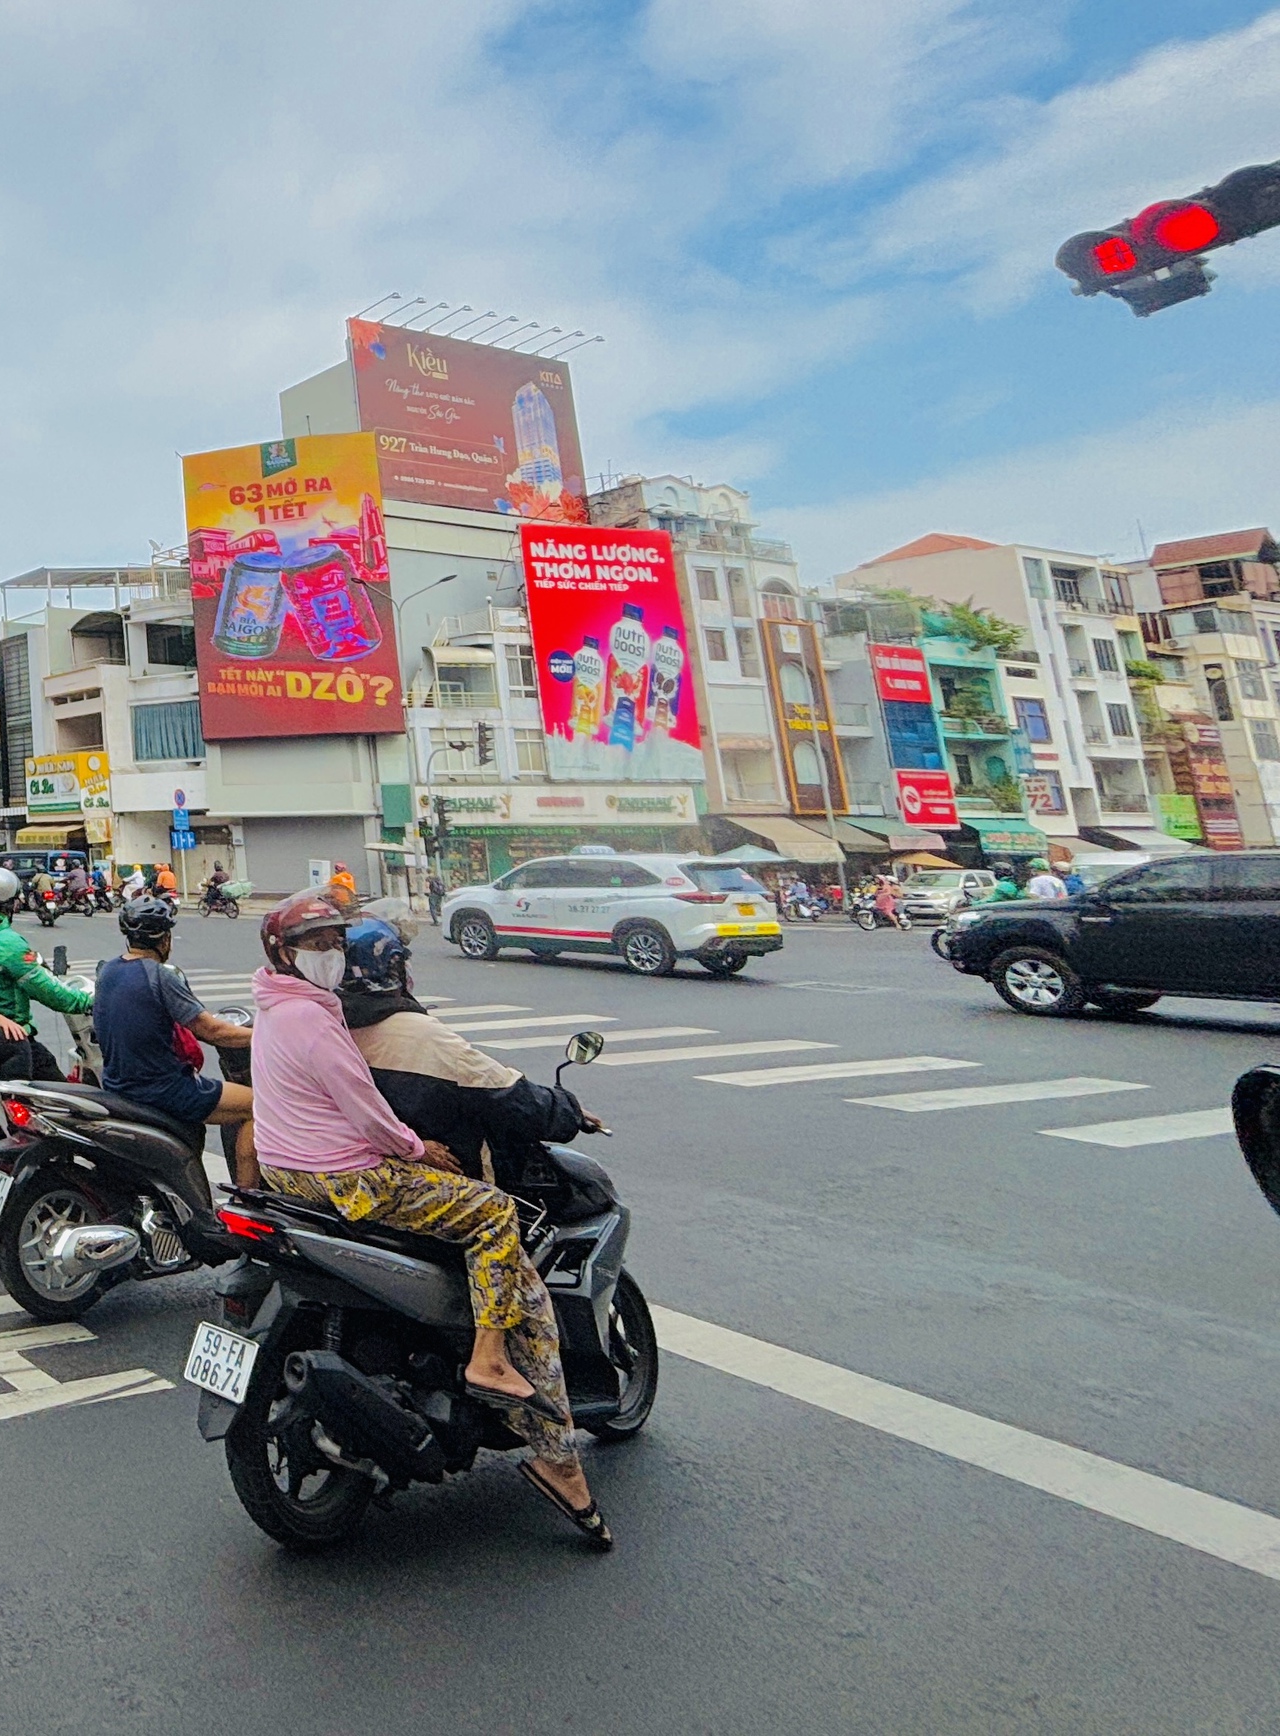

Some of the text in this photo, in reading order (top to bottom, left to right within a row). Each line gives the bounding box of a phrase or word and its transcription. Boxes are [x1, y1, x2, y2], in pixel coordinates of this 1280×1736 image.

[406, 343, 448, 377] Kiều
[380, 435, 407, 453] 927
[429, 445, 453, 459] Hưng
[471, 452, 493, 464] Quận
[493, 456, 499, 464] 5
[229, 477, 333, 506] 63 MỞ RA
[254, 497, 308, 525] 1 TẾT
[530, 539, 666, 566] NĂNG LƯỢNG.
[531, 561, 659, 583] THƠM NGON.
[534, 577, 630, 592] TIẾP SỨC CHIẾN TIẾP
[239, 616, 257, 625] BIA
[615, 626, 646, 643] nutri
[613, 639, 646, 657] boost
[656, 643, 681, 656] nutri
[577, 652, 600, 665] nutri
[655, 653, 681, 668] boost
[219, 666, 277, 682] TẾT NÀY
[576, 662, 600, 677] boost
[266, 685, 282, 697] AI
[1027, 793, 1052, 808] 72
[202, 1329, 247, 1370] 59-FA
[190, 1354, 242, 1398] 086.74
